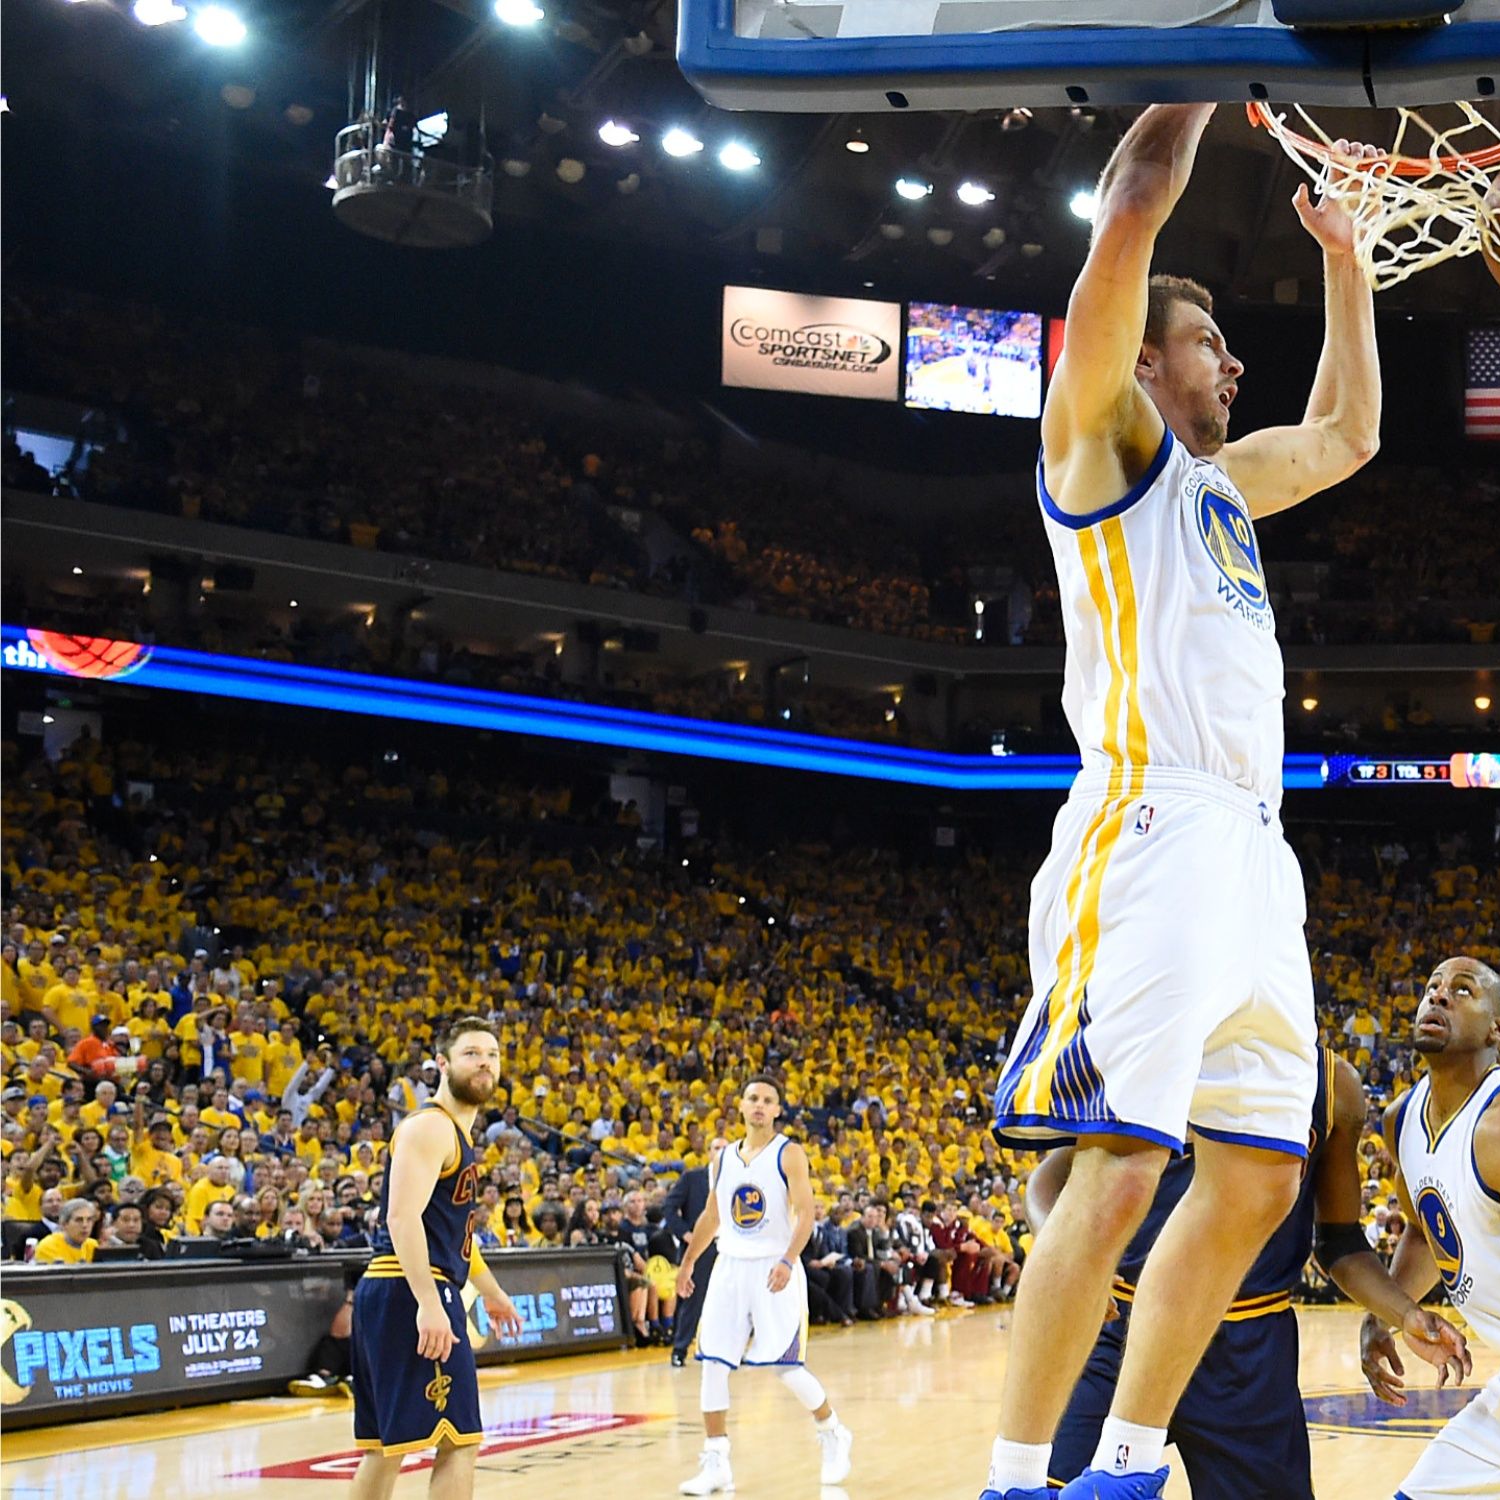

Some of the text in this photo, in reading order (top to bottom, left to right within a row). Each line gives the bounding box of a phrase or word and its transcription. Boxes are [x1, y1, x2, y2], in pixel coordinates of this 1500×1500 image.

[737, 324, 842, 347] comcast
[757, 342, 871, 364] SPORTSNET
[1228, 512, 1251, 547] 10
[745, 1190, 760, 1206] 30
[1436, 1211, 1447, 1239] 9
[568, 1298, 614, 1318] JULY 24
[169, 1309, 267, 1334] IN THEATERS
[182, 1328, 260, 1356] JULY 24
[13, 1323, 161, 1386] PIXELS
[53, 1377, 134, 1400] THE MOVIE
